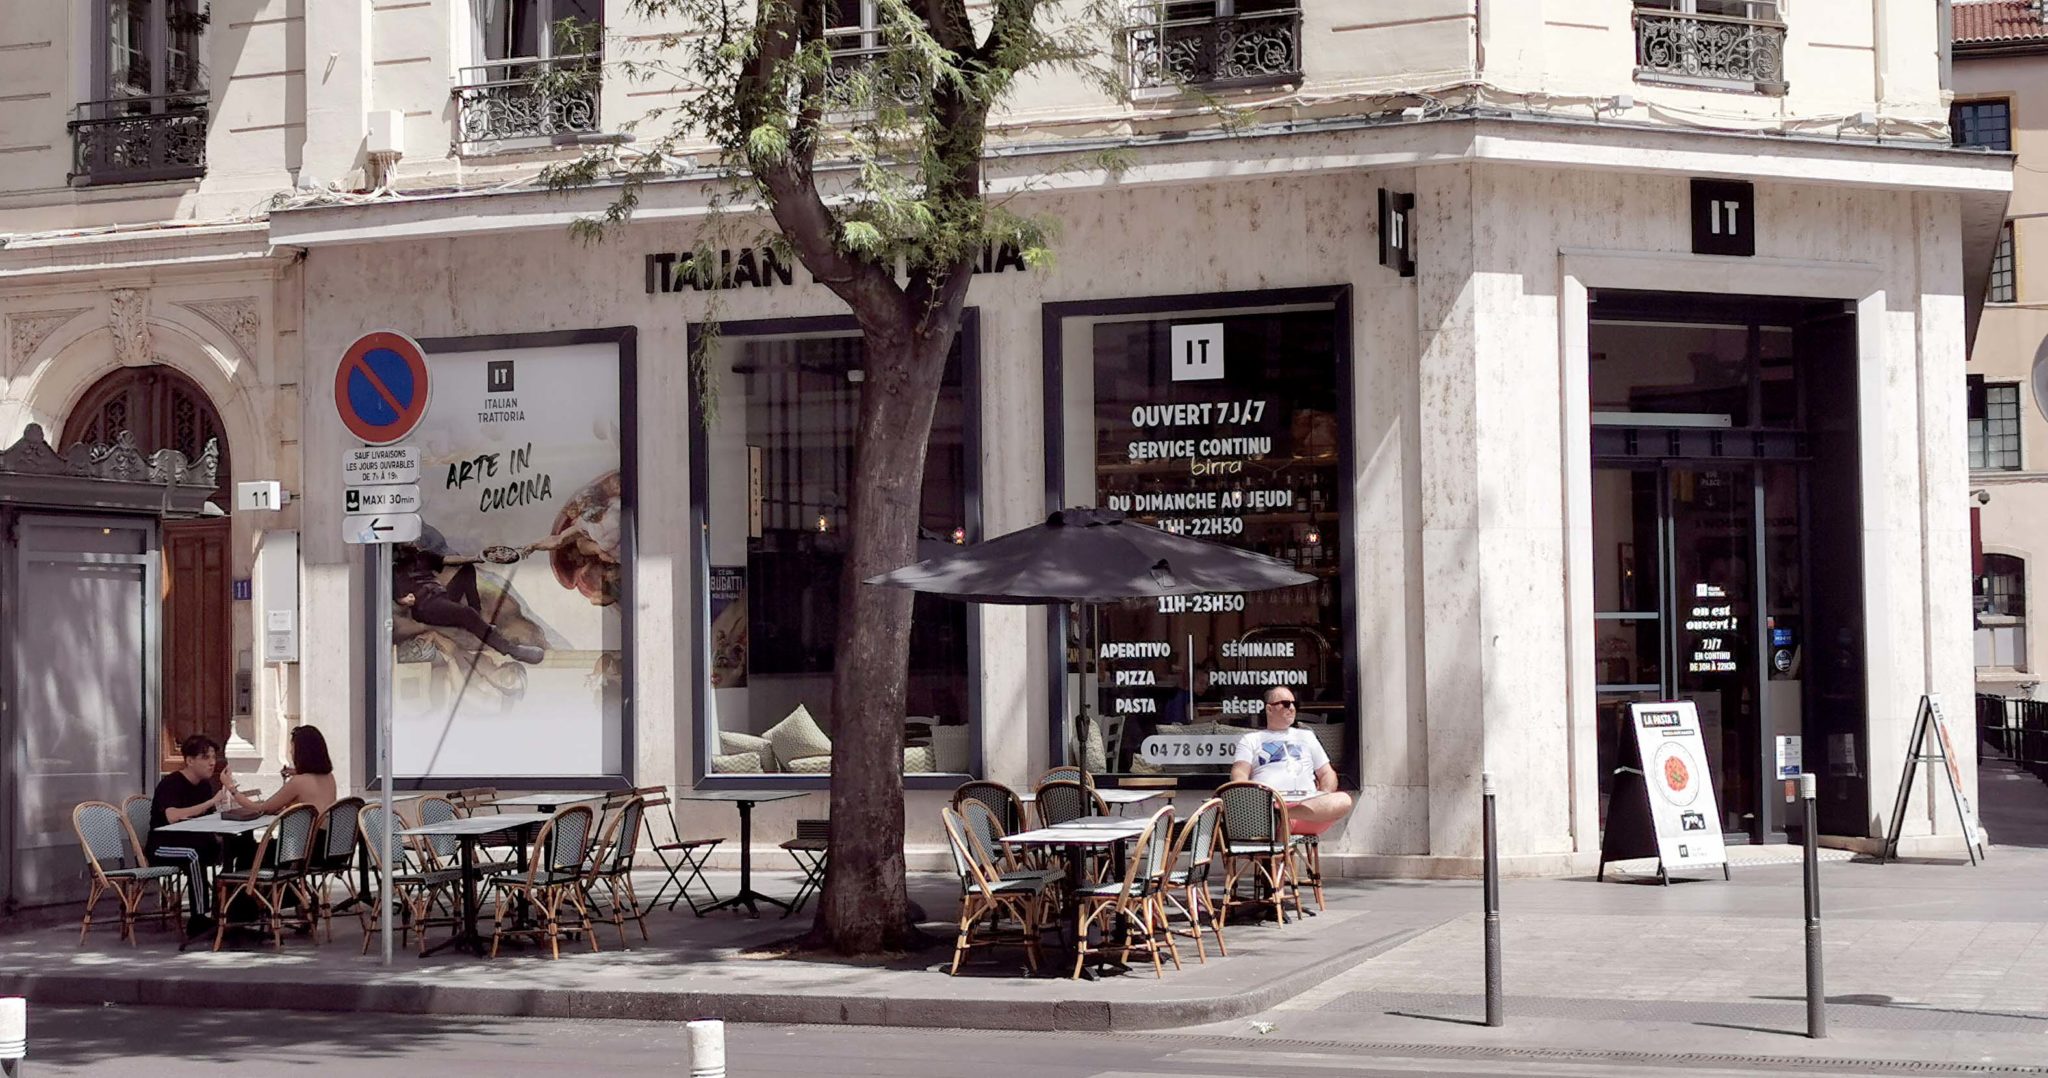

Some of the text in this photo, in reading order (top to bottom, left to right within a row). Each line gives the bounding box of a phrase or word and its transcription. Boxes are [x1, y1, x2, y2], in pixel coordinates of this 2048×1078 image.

[1711, 200, 1739, 234] IT
[1391, 209, 1403, 249] IT
[1186, 339, 1210, 364] IT
[494, 368, 508, 384] IT
[484, 398, 518, 409] ITALIAN
[478, 411, 525, 423] TRATTORIA
[1132, 399, 1266, 428] OUVERT 7J/7
[354, 449, 406, 460] SAUF LIVRAISONS
[1128, 436, 1271, 459] SERVICE CONTINU
[346, 460, 415, 471] LES JOURS OUVRABLES
[446, 442, 532, 490] ARTE IN
[1190, 455, 1242, 476] birra
[362, 473, 371, 481] DE
[252, 491, 269, 507] 11
[362, 493, 415, 505] MAXI 30min
[480, 473, 552, 512] CUCINA
[1109, 489, 1292, 511] DU DIMANCHE AU JEUDI
[1157, 517, 1243, 535] 11H-22H30
[236, 582, 249, 599] 11
[711, 576, 743, 590] BUGATTI
[1158, 594, 1245, 613] 11H-23H30
[1692, 605, 1731, 616] on est
[1686, 619, 1729, 630] ouvert
[1100, 642, 1171, 658] APERITIVO
[1222, 639, 1294, 657] SÉMINAIRE
[1694, 651, 1730, 660] EN CONTINU
[1689, 662, 1698, 672] DE
[1116, 670, 1155, 686] PIZZA
[1209, 670, 1307, 685] PRIVATISATION
[1116, 698, 1156, 713] PASTA
[1222, 695, 1265, 714] RÉCEP
[1150, 743, 1236, 756] 04 78 69 50
